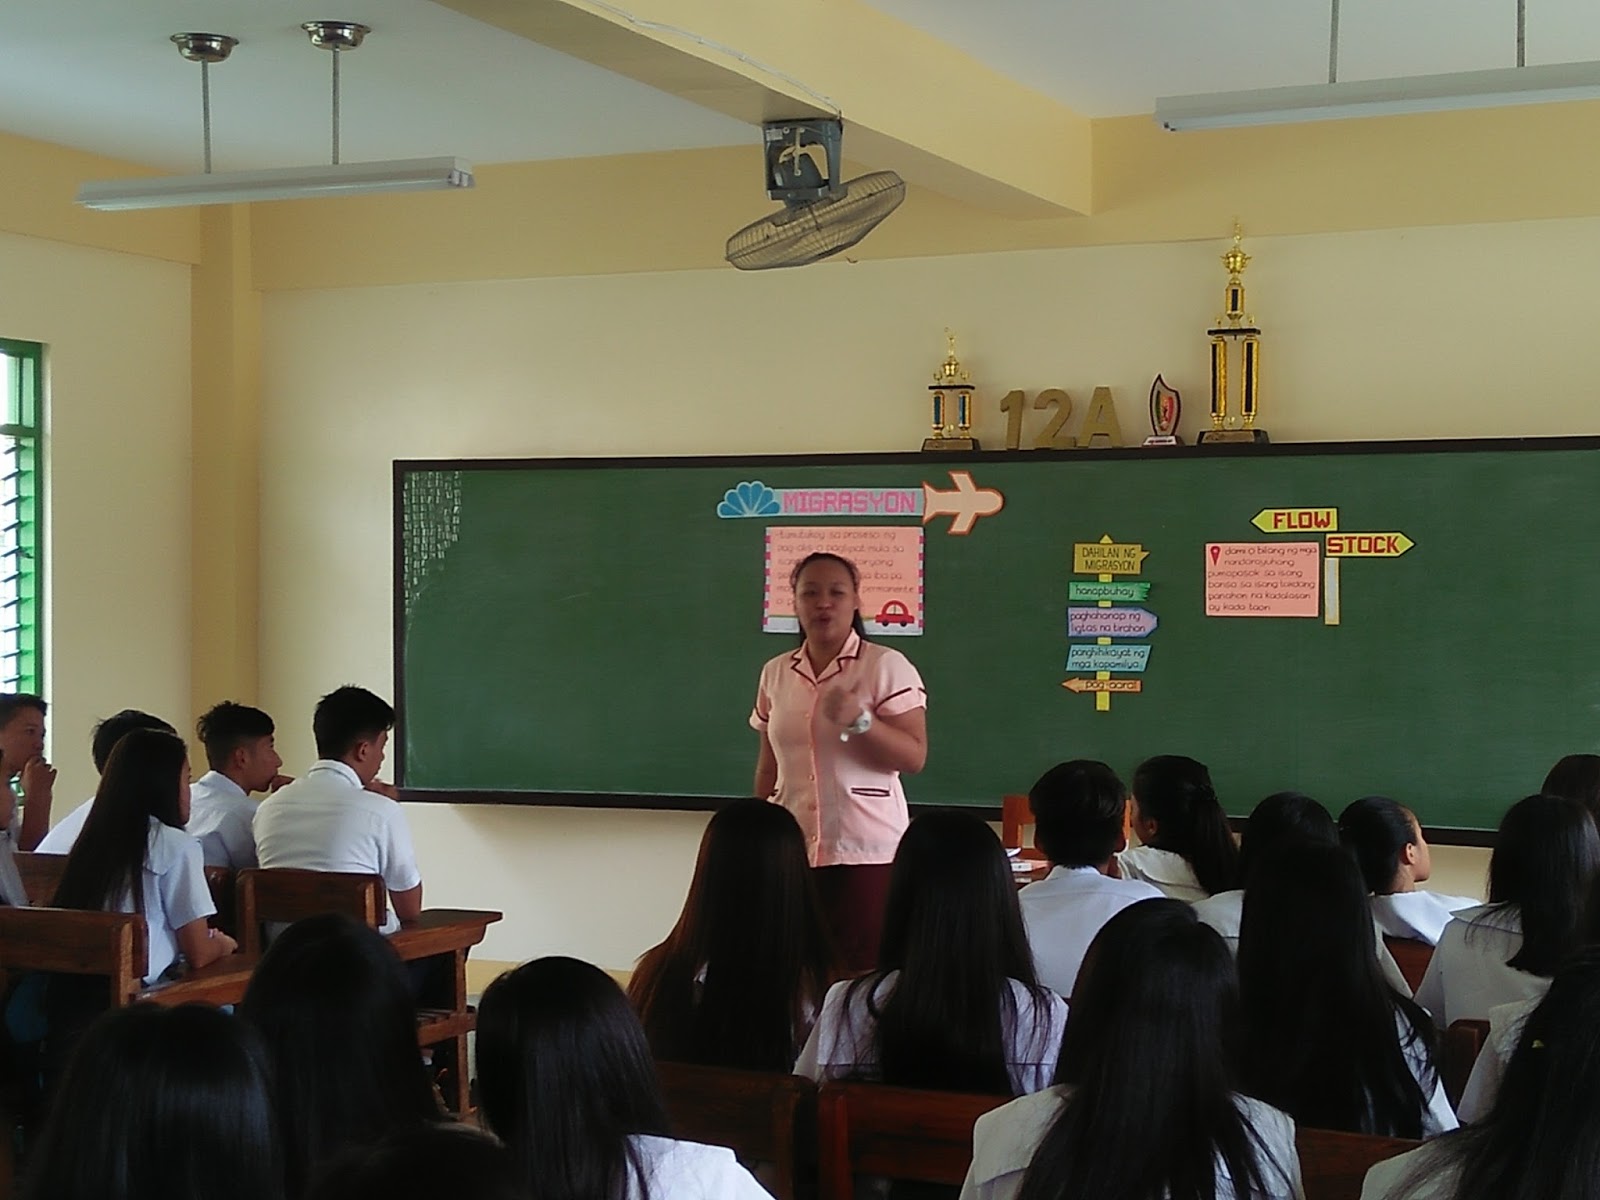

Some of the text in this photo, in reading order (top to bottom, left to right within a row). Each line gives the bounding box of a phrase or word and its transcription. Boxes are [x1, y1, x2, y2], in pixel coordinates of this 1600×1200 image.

[1000, 386, 1122, 450] 12A
[783, 491, 915, 513] MIGRASYON
[1273, 511, 1331, 529] FLOW
[843, 531, 880, 541] proseso
[884, 532, 896, 540] ng
[1327, 536, 1400, 554] STOCK
[1082, 547, 1136, 558] DAHILAN NG
[1225, 547, 1246, 555] dami
[1257, 546, 1285, 556] bilang
[1287, 547, 1298, 556] ng
[1299, 547, 1317, 556] mga
[1085, 560, 1135, 571] MIGRASYON
[1224, 557, 1295, 567] nandarayuhang
[1208, 569, 1259, 579] pumapasok
[1278, 569, 1303, 578] isang
[1208, 580, 1237, 588] bansa
[1255, 580, 1278, 589] isang
[1280, 580, 1315, 589] takdang
[1075, 584, 1134, 598] hanapbuhay
[1208, 592, 1248, 601] panahon
[1265, 590, 1311, 599] kadalasan
[1208, 602, 1271, 612] ay kada taon
[1071, 611, 1141, 622] paghahanap ng
[1071, 623, 1097, 634] ligtas
[1114, 623, 1146, 632] tirahan
[1071, 647, 1145, 659] panghihikayat ng
[1072, 659, 1139, 669] mga kapamilya
